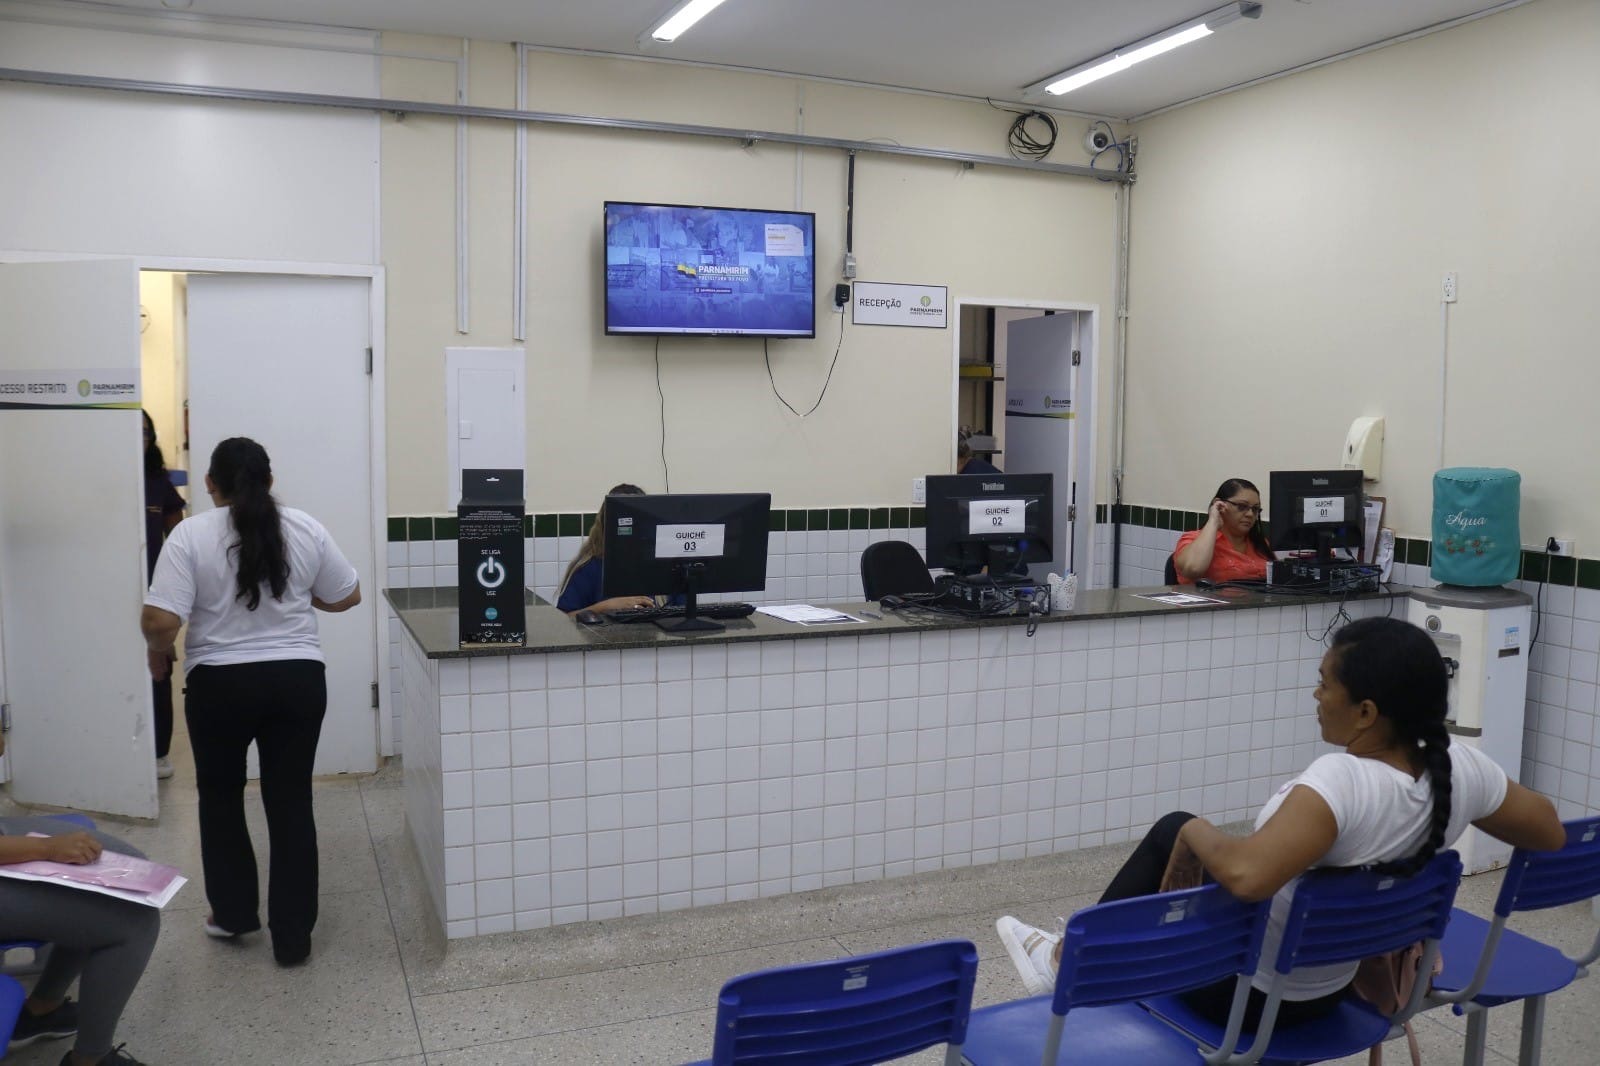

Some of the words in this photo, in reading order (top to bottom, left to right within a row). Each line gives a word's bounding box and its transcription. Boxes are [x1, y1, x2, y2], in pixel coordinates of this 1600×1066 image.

[698, 265, 749, 275] PARNAMIRIM
[859, 298, 902, 310] RECEPÇÃO
[27, 383, 67, 394] RESTRITO
[1320, 508, 1328, 516] 01
[992, 516, 1003, 526] 02
[684, 541, 697, 551] 03
